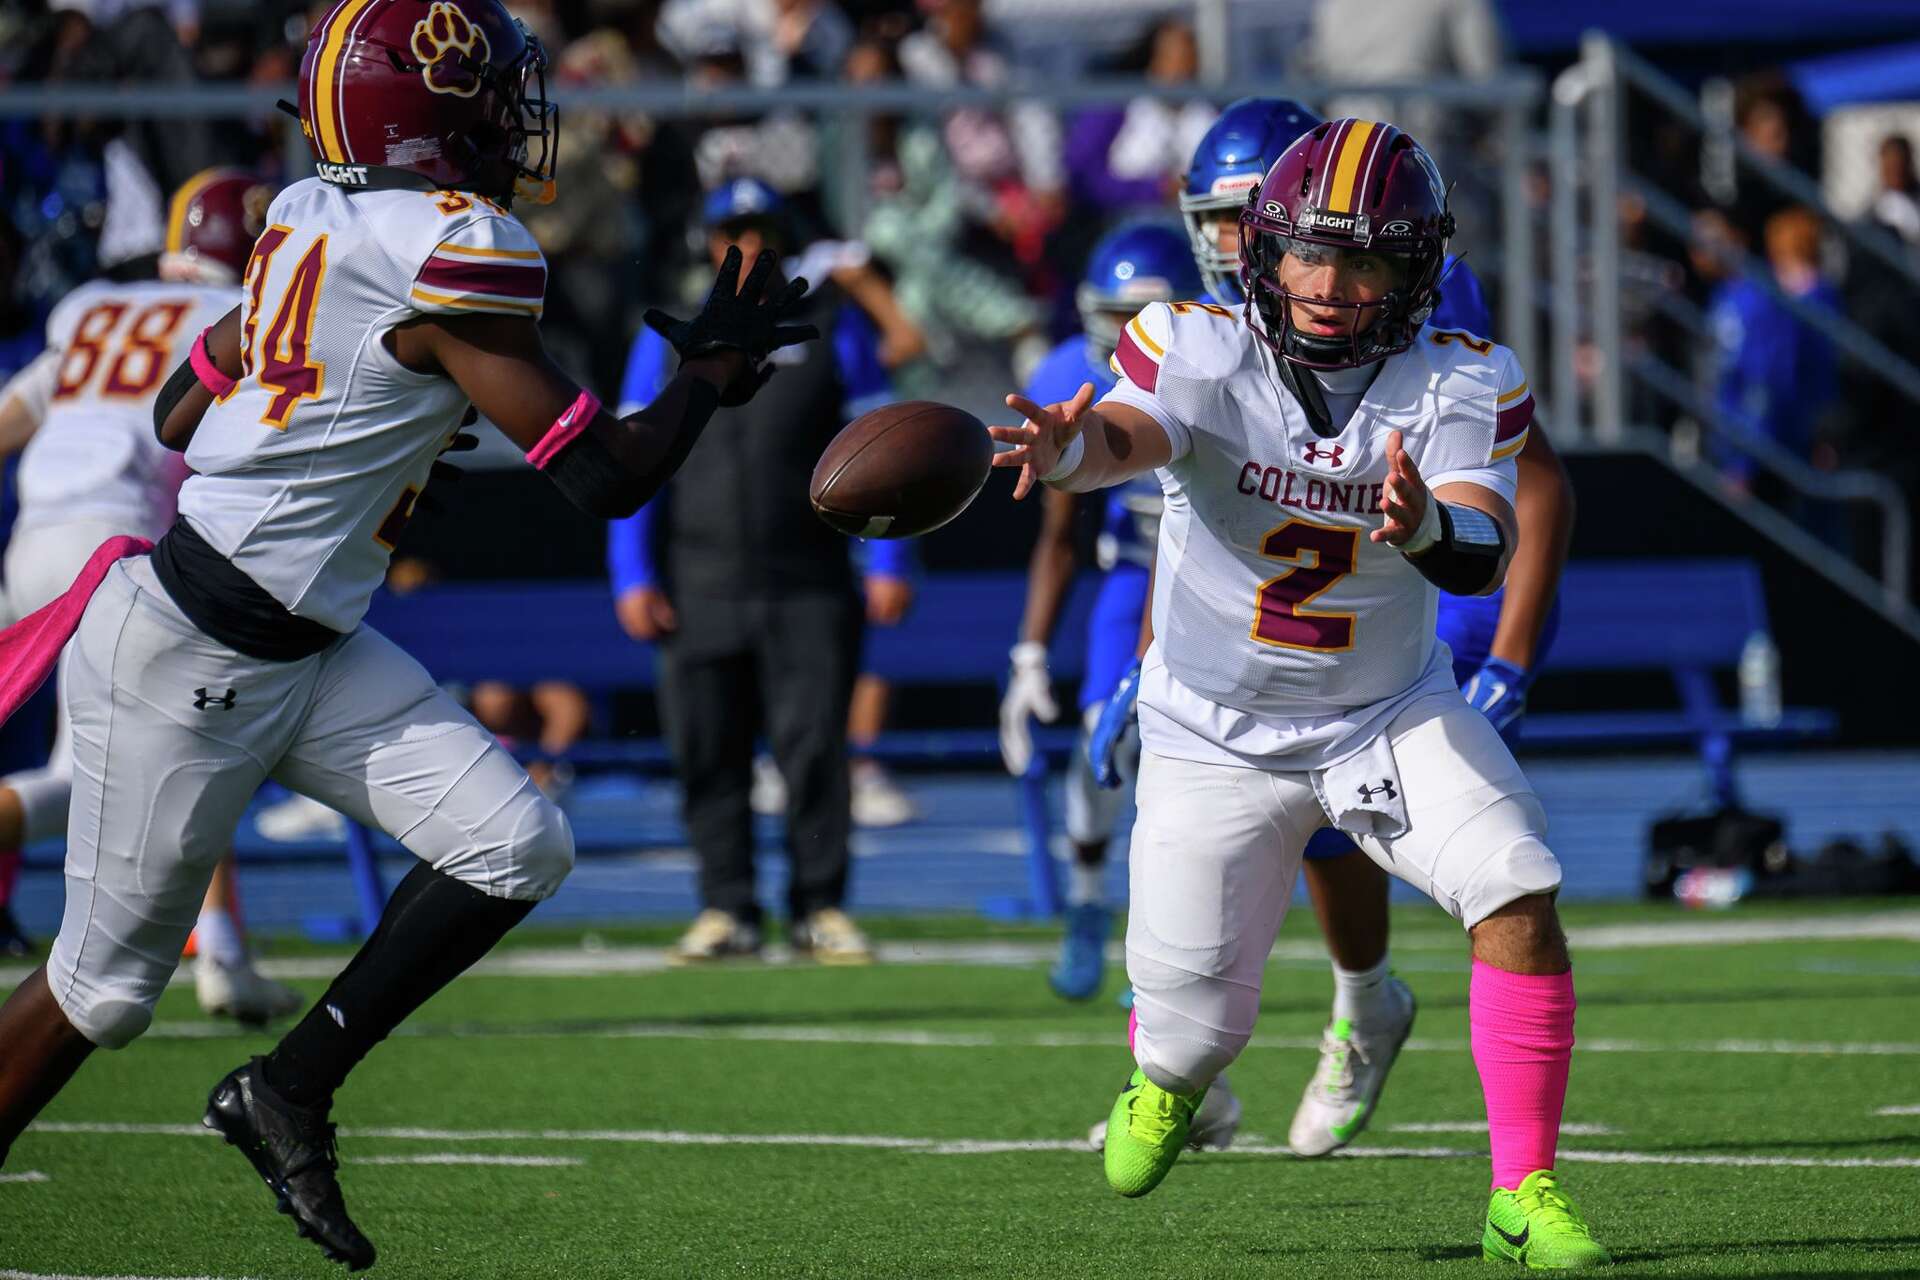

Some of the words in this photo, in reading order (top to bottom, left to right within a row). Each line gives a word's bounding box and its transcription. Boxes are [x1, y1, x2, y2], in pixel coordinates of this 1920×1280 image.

[316, 162, 368, 185] LIGHT
[1315, 214, 1355, 230] LIGHT
[52, 298, 194, 402] 88
[1429, 330, 1495, 357] 2
[1236, 460, 1384, 514] COLONIE
[1249, 517, 1361, 653] 2
